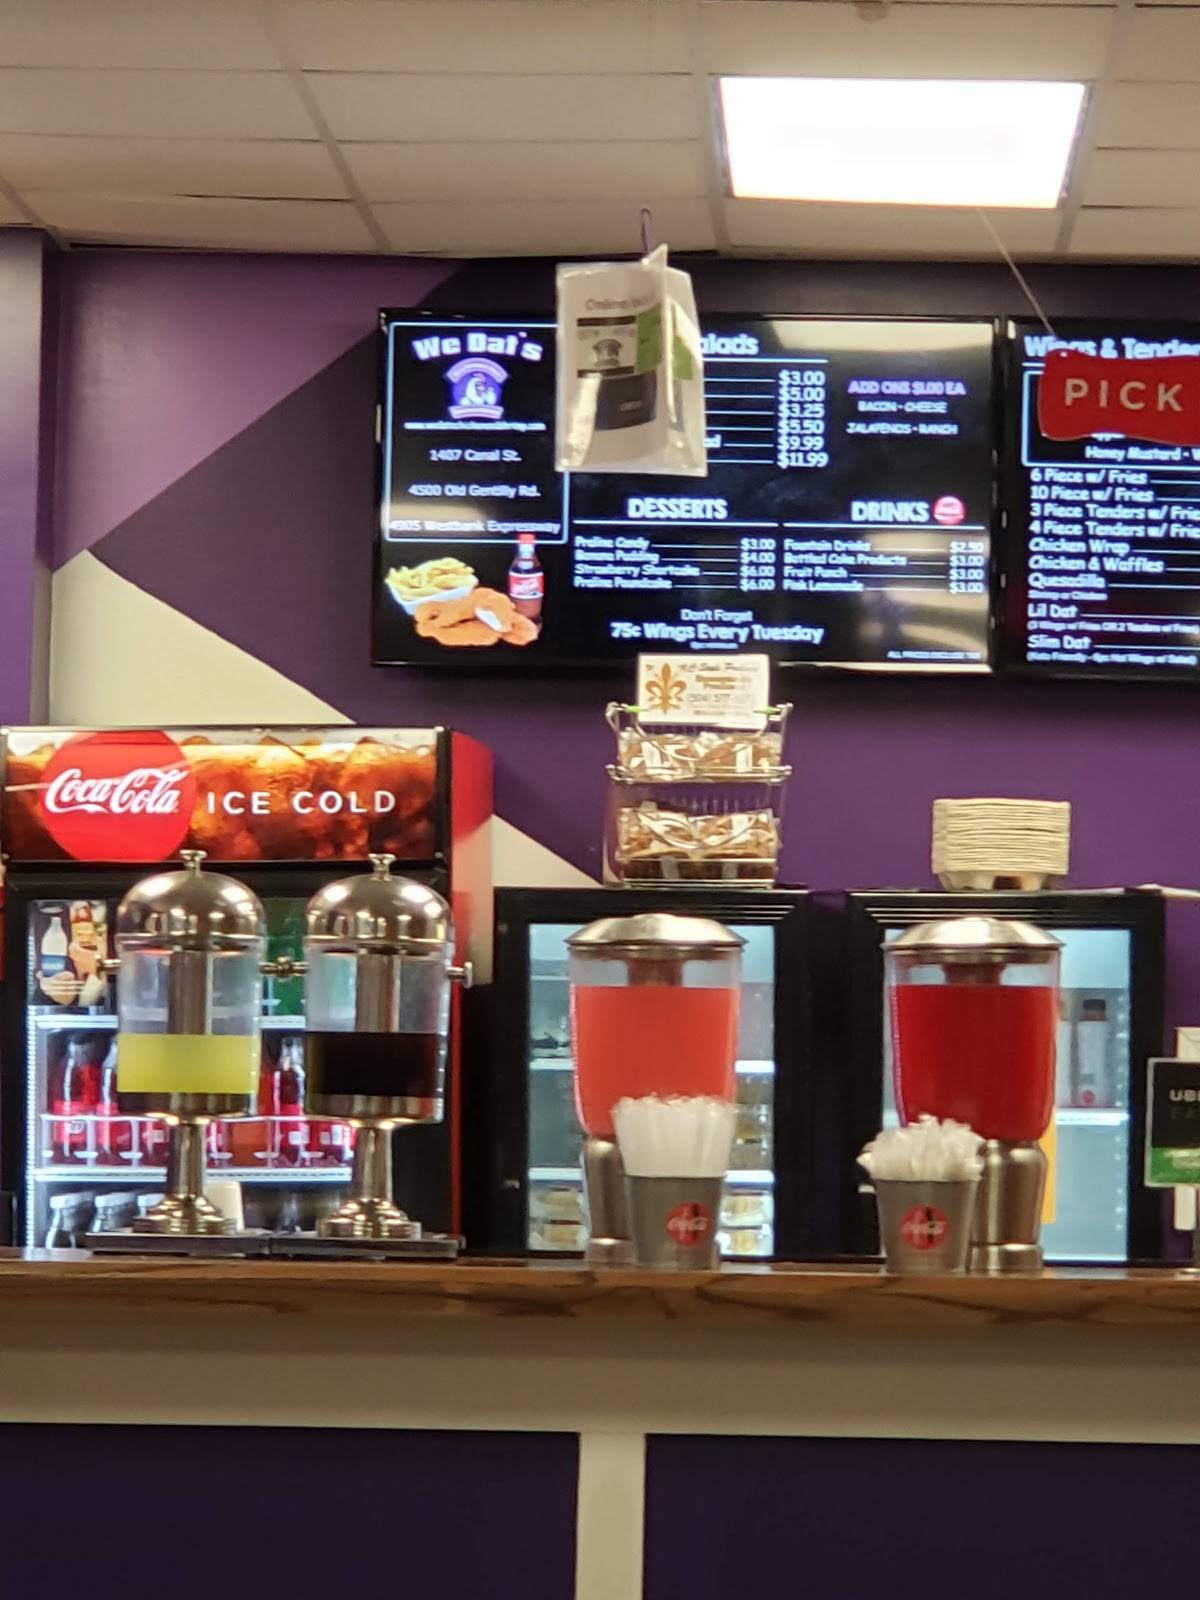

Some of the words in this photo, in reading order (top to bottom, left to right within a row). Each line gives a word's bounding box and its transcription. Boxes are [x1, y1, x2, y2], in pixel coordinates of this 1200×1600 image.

[412, 336, 462, 361] We
[466, 332, 543, 361] Dat's
[699, 333, 760, 356] alads
[1100, 338, 1118, 359] &
[779, 370, 826, 388] $3.00
[848, 380, 880, 394] ADD
[945, 382, 967, 395] EA
[778, 387, 826, 403] $5.00
[1064, 377, 1184, 413] PICK
[778, 403, 825, 419] $3.25
[778, 420, 824, 436] $5.50
[777, 436, 825, 452] $9.99
[777, 452, 828, 469] $11.99
[1030, 469, 1042, 483] 6
[1044, 469, 1084, 483] Piece
[1108, 470, 1148, 485] Fries
[1030, 486, 1049, 500] 10
[1051, 486, 1090, 501] Piece
[1114, 487, 1154, 502] Fries
[626, 497, 729, 519] DESSERTS
[850, 500, 930, 522] DRINKS
[1030, 504, 1042, 517] 3
[1043, 503, 1084, 517] Piece
[1085, 504, 1146, 520] Tenders
[1170, 506, 1200, 521] Frie
[1028, 520, 1042, 533] 4
[1043, 520, 1084, 535] Piece
[1085, 521, 1146, 537] Tenders
[1169, 523, 1200, 538] Frie
[740, 538, 776, 551] $3.00
[1028, 537, 1086, 553] Chicken
[1088, 539, 1130, 556] Wrap
[1028, 555, 1086, 570] Chicken
[1102, 556, 1164, 572] Waffles
[714, 610, 753, 624] Forget
[1027, 603, 1047, 617] Lil
[1049, 604, 1079, 618] Dat
[643, 623, 696, 642] Wings
[697, 624, 749, 643] Every
[752, 625, 824, 645] Tuesday
[1027, 634, 1061, 649] Slim
[1062, 635, 1092, 650] Dat
[45, 767, 189, 814] Coca-Cola
[207, 791, 271, 815] ICE
[291, 790, 397, 814] COLD
[1169, 1088, 1200, 1102] UB
